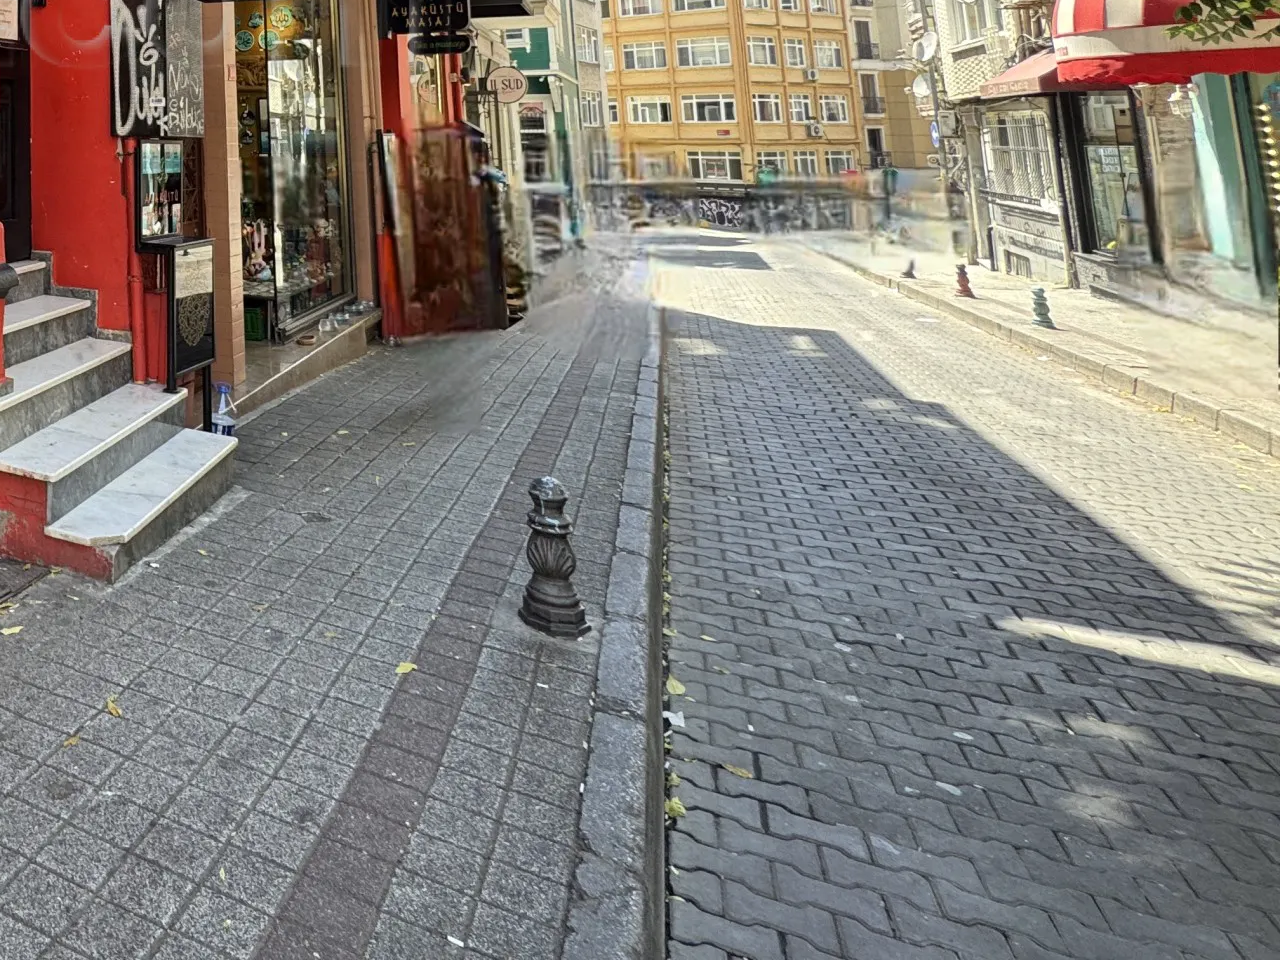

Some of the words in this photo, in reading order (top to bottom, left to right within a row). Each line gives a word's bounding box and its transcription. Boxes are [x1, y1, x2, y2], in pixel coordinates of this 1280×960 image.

[391, 1, 464, 17] AYAKÜSTÜ
[405, 16, 451, 28] MASAJ
[490, 79, 499, 91] IL
[501, 78, 523, 91] SUD
